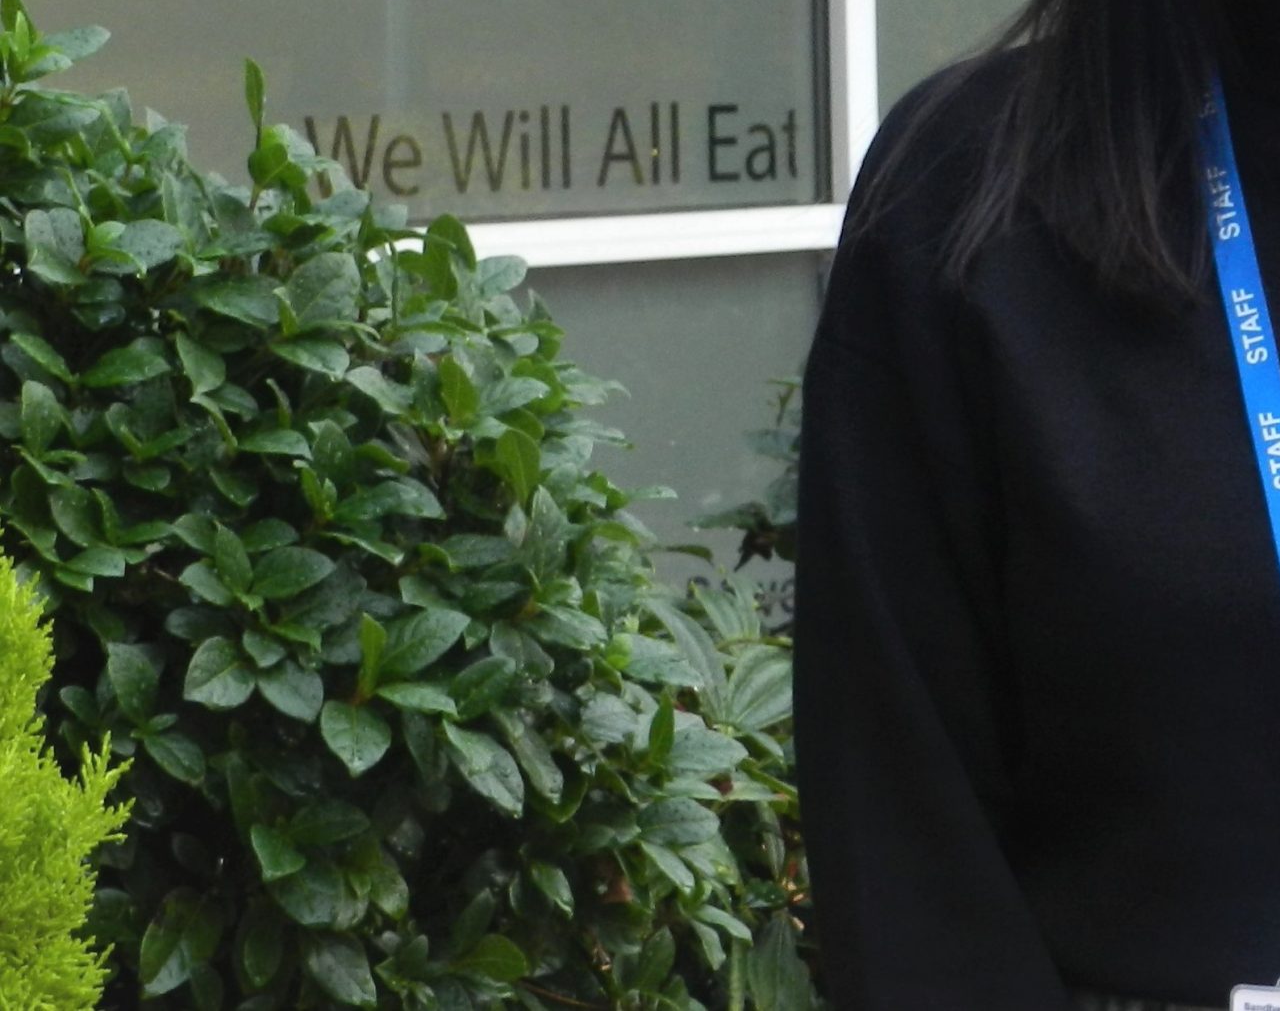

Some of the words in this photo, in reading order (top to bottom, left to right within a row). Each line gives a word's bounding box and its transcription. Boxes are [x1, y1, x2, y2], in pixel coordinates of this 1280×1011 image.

[304, 113, 423, 198] We
[442, 104, 571, 193] Will
[597, 101, 681, 186] All
[706, 102, 798, 183] Eat
[1231, 288, 1268, 364] STAFF
